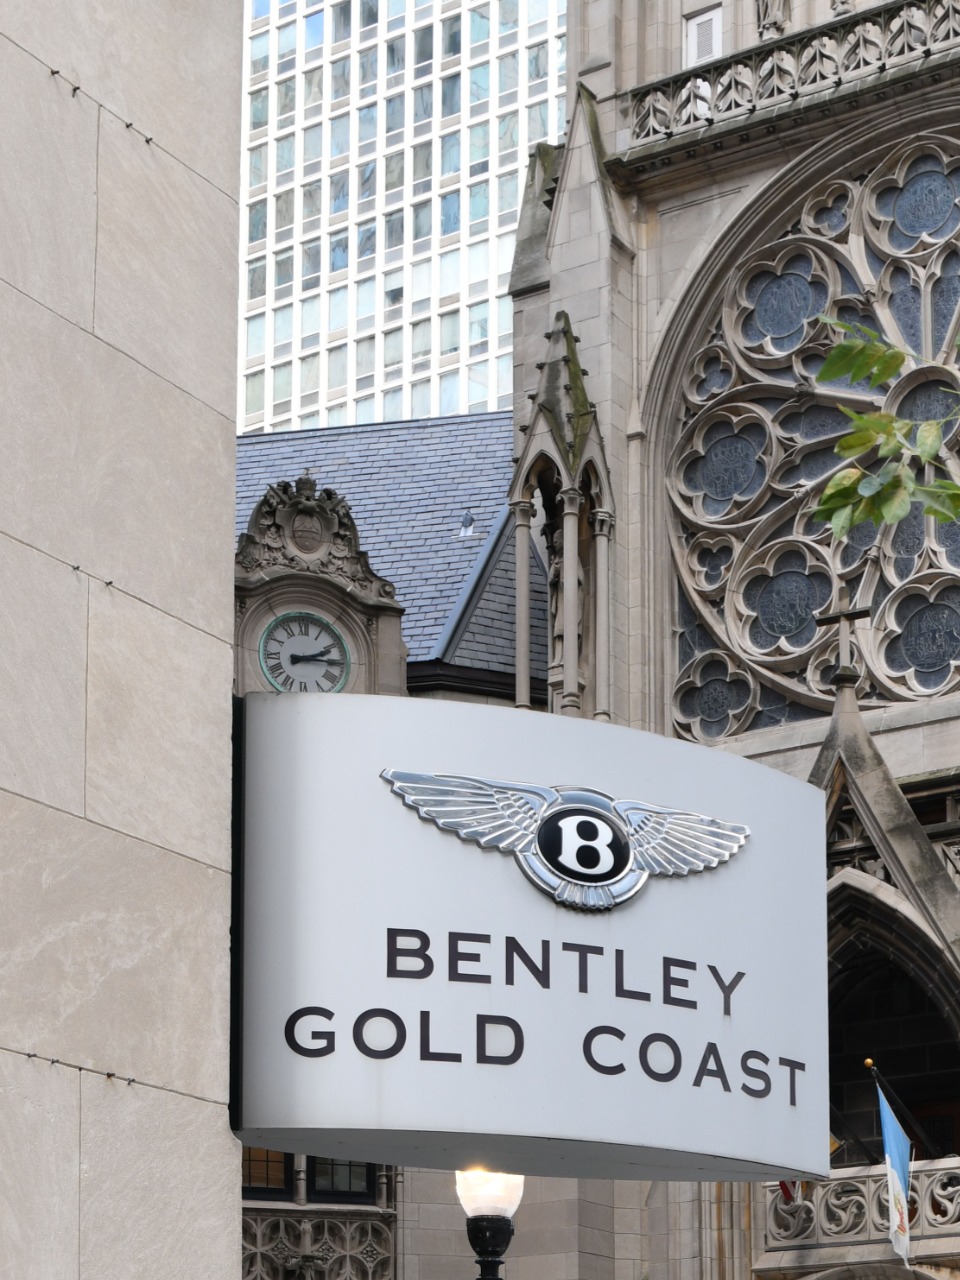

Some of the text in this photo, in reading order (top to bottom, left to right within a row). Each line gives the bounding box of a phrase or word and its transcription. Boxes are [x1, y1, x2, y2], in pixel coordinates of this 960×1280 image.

[557, 814, 616, 875] B
[386, 927, 746, 1016] BENTLEY
[284, 1005, 806, 1107] GOLD COAST
